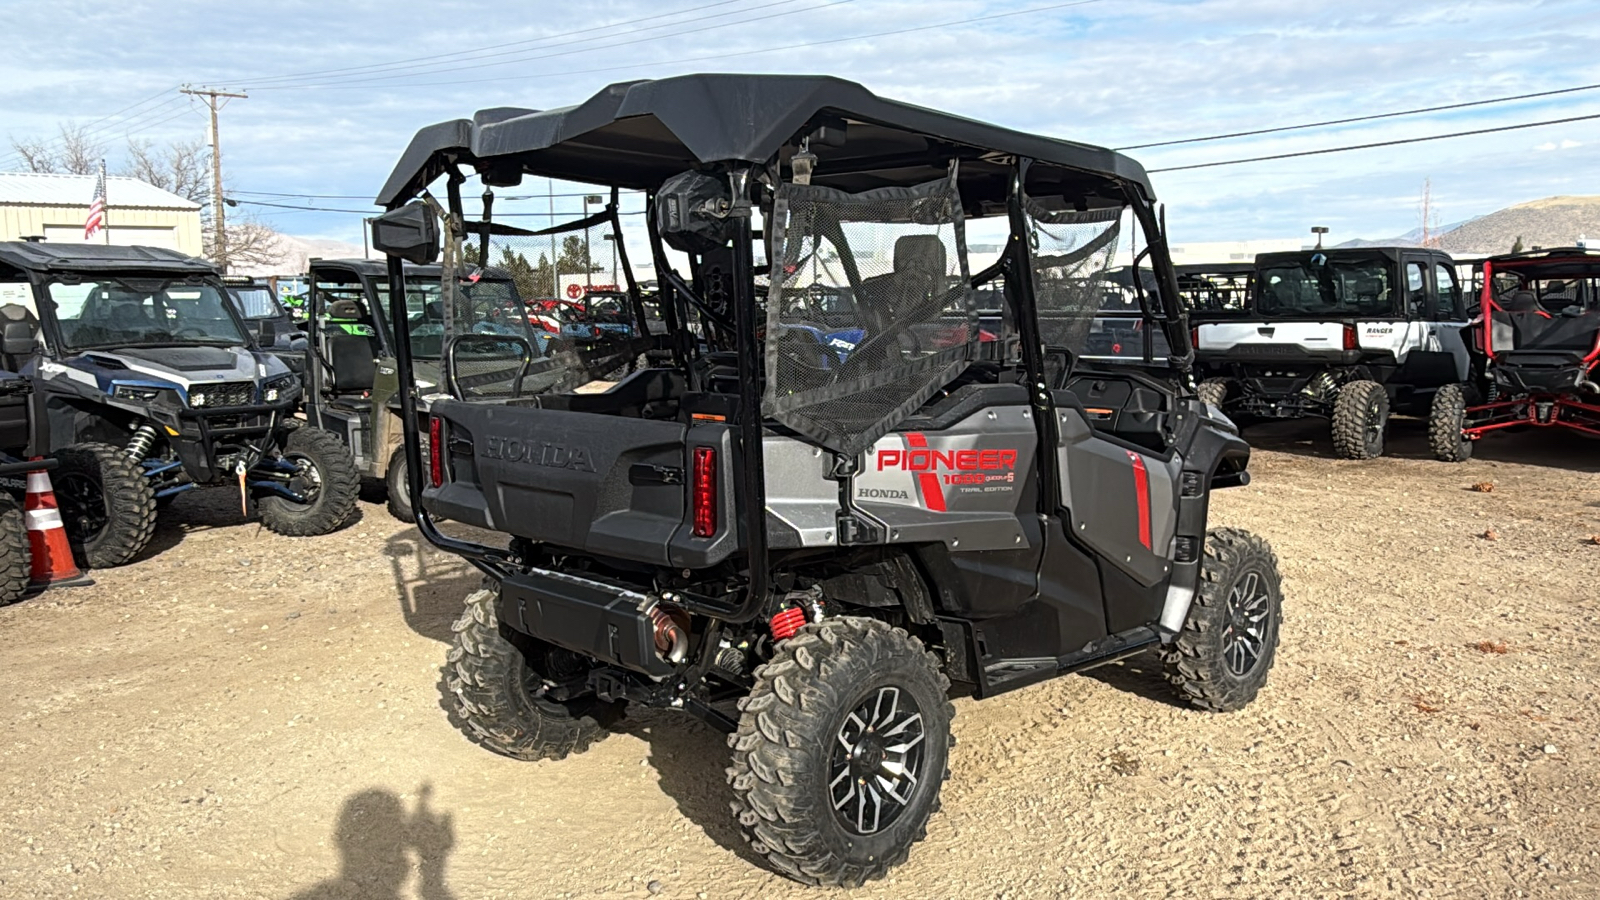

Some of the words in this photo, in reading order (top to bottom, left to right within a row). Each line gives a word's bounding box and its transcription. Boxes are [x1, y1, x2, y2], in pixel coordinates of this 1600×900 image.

[481, 436, 598, 474] HONDA
[877, 449, 1018, 471] PIONEER
[943, 473, 985, 485] 1000
[858, 488, 909, 499] HONDA
